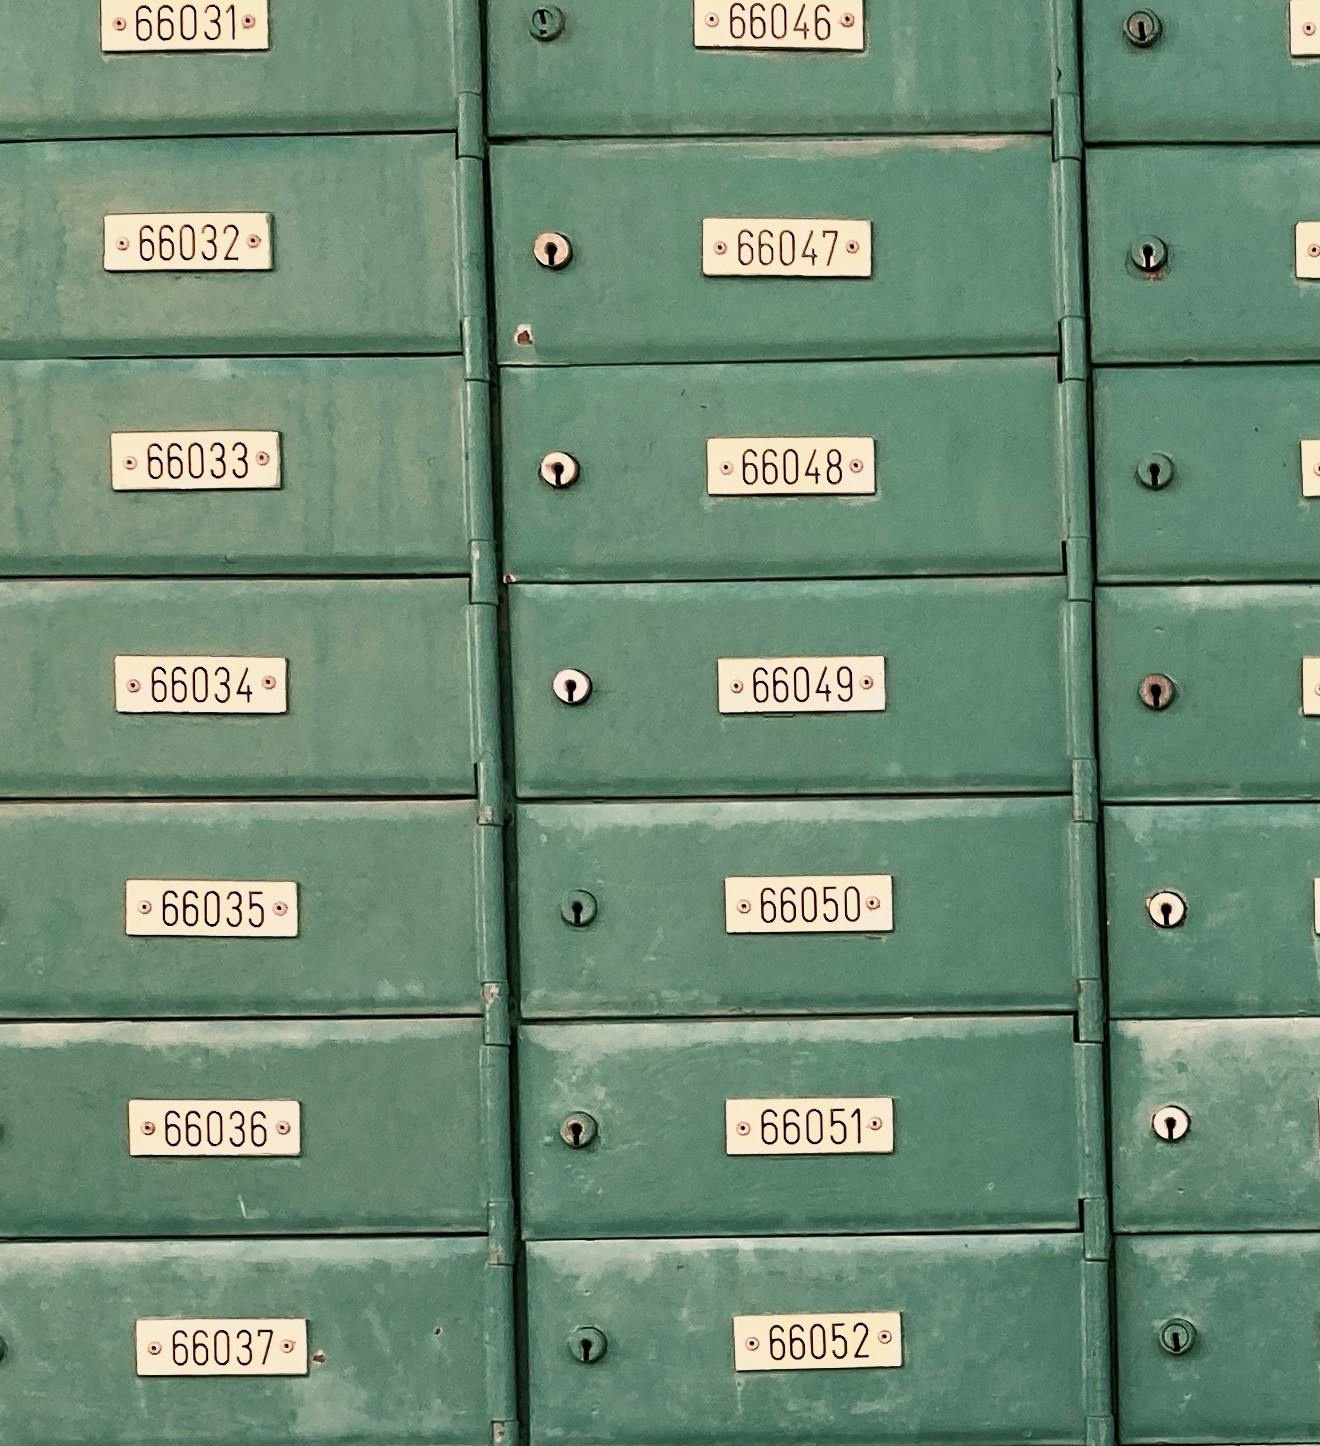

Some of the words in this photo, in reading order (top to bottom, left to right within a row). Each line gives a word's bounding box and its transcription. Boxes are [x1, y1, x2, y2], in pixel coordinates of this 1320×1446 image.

[135, 3, 236, 42] 66031
[729, 2, 831, 41] 66046
[139, 223, 240, 262] 66032
[737, 228, 839, 267] 66047
[146, 441, 249, 480] 66033
[742, 448, 843, 486] 66048
[151, 666, 254, 704] 66034
[752, 665, 854, 704] 66049
[162, 889, 265, 928] 66035
[760, 885, 861, 924] 66050
[164, 1110, 268, 1148] 66036
[760, 1107, 862, 1146] 66051
[172, 1329, 274, 1367] 66037
[769, 1321, 870, 1361] 66052
